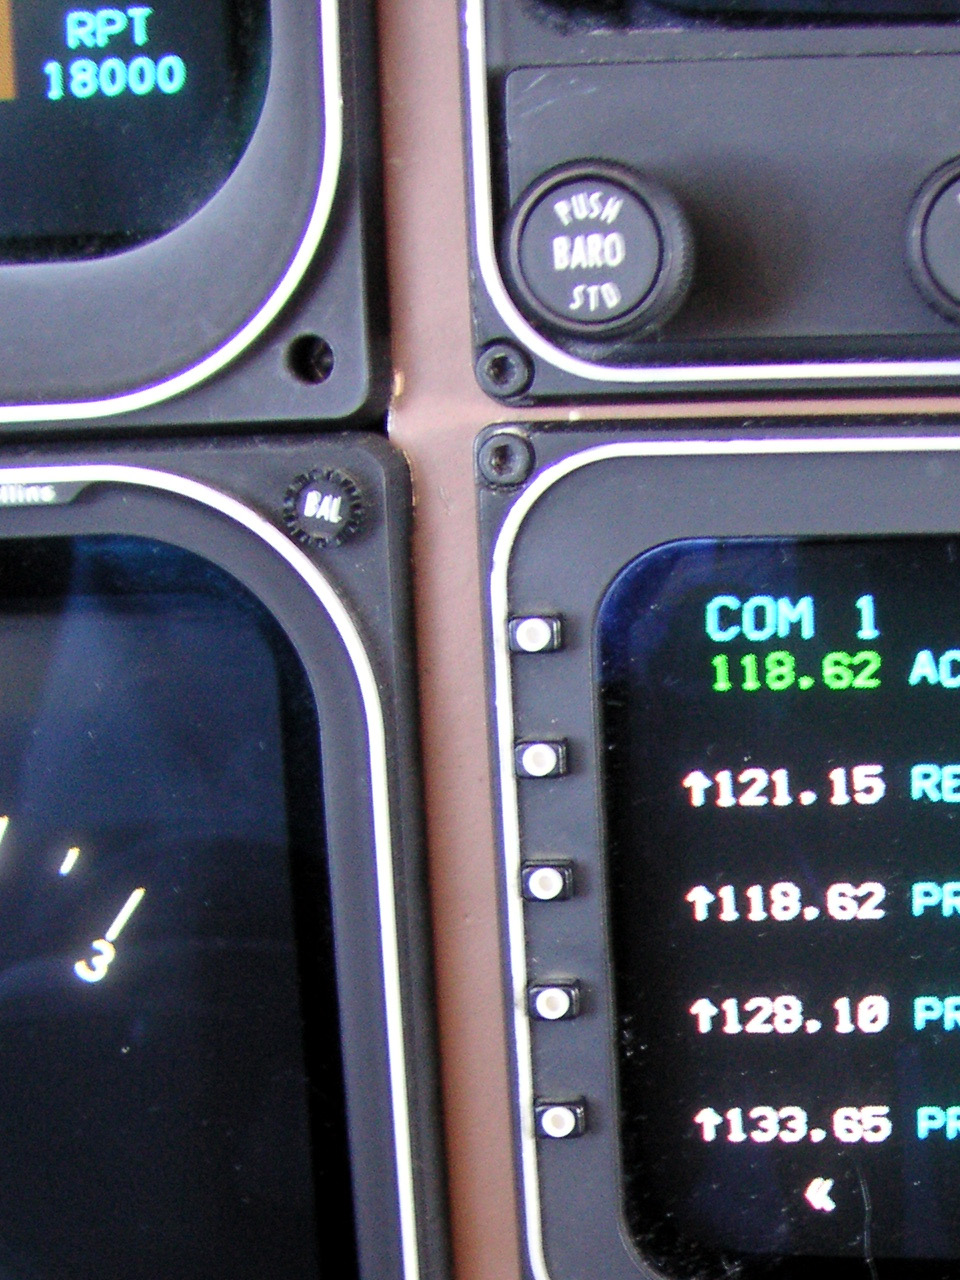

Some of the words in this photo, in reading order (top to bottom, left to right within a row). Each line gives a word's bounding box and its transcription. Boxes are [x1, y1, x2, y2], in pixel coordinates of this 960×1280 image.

[66, 6, 153, 48] RPT
[44, 55, 187, 100] 18000
[554, 191, 624, 227] PUSH
[552, 233, 626, 271] BARO
[568, 282, 622, 312] STD
[706, 595, 815, 641] COM
[855, 596, 880, 638] 1
[711, 651, 882, 691] 118.62
[74, 939, 117, 983] 3
